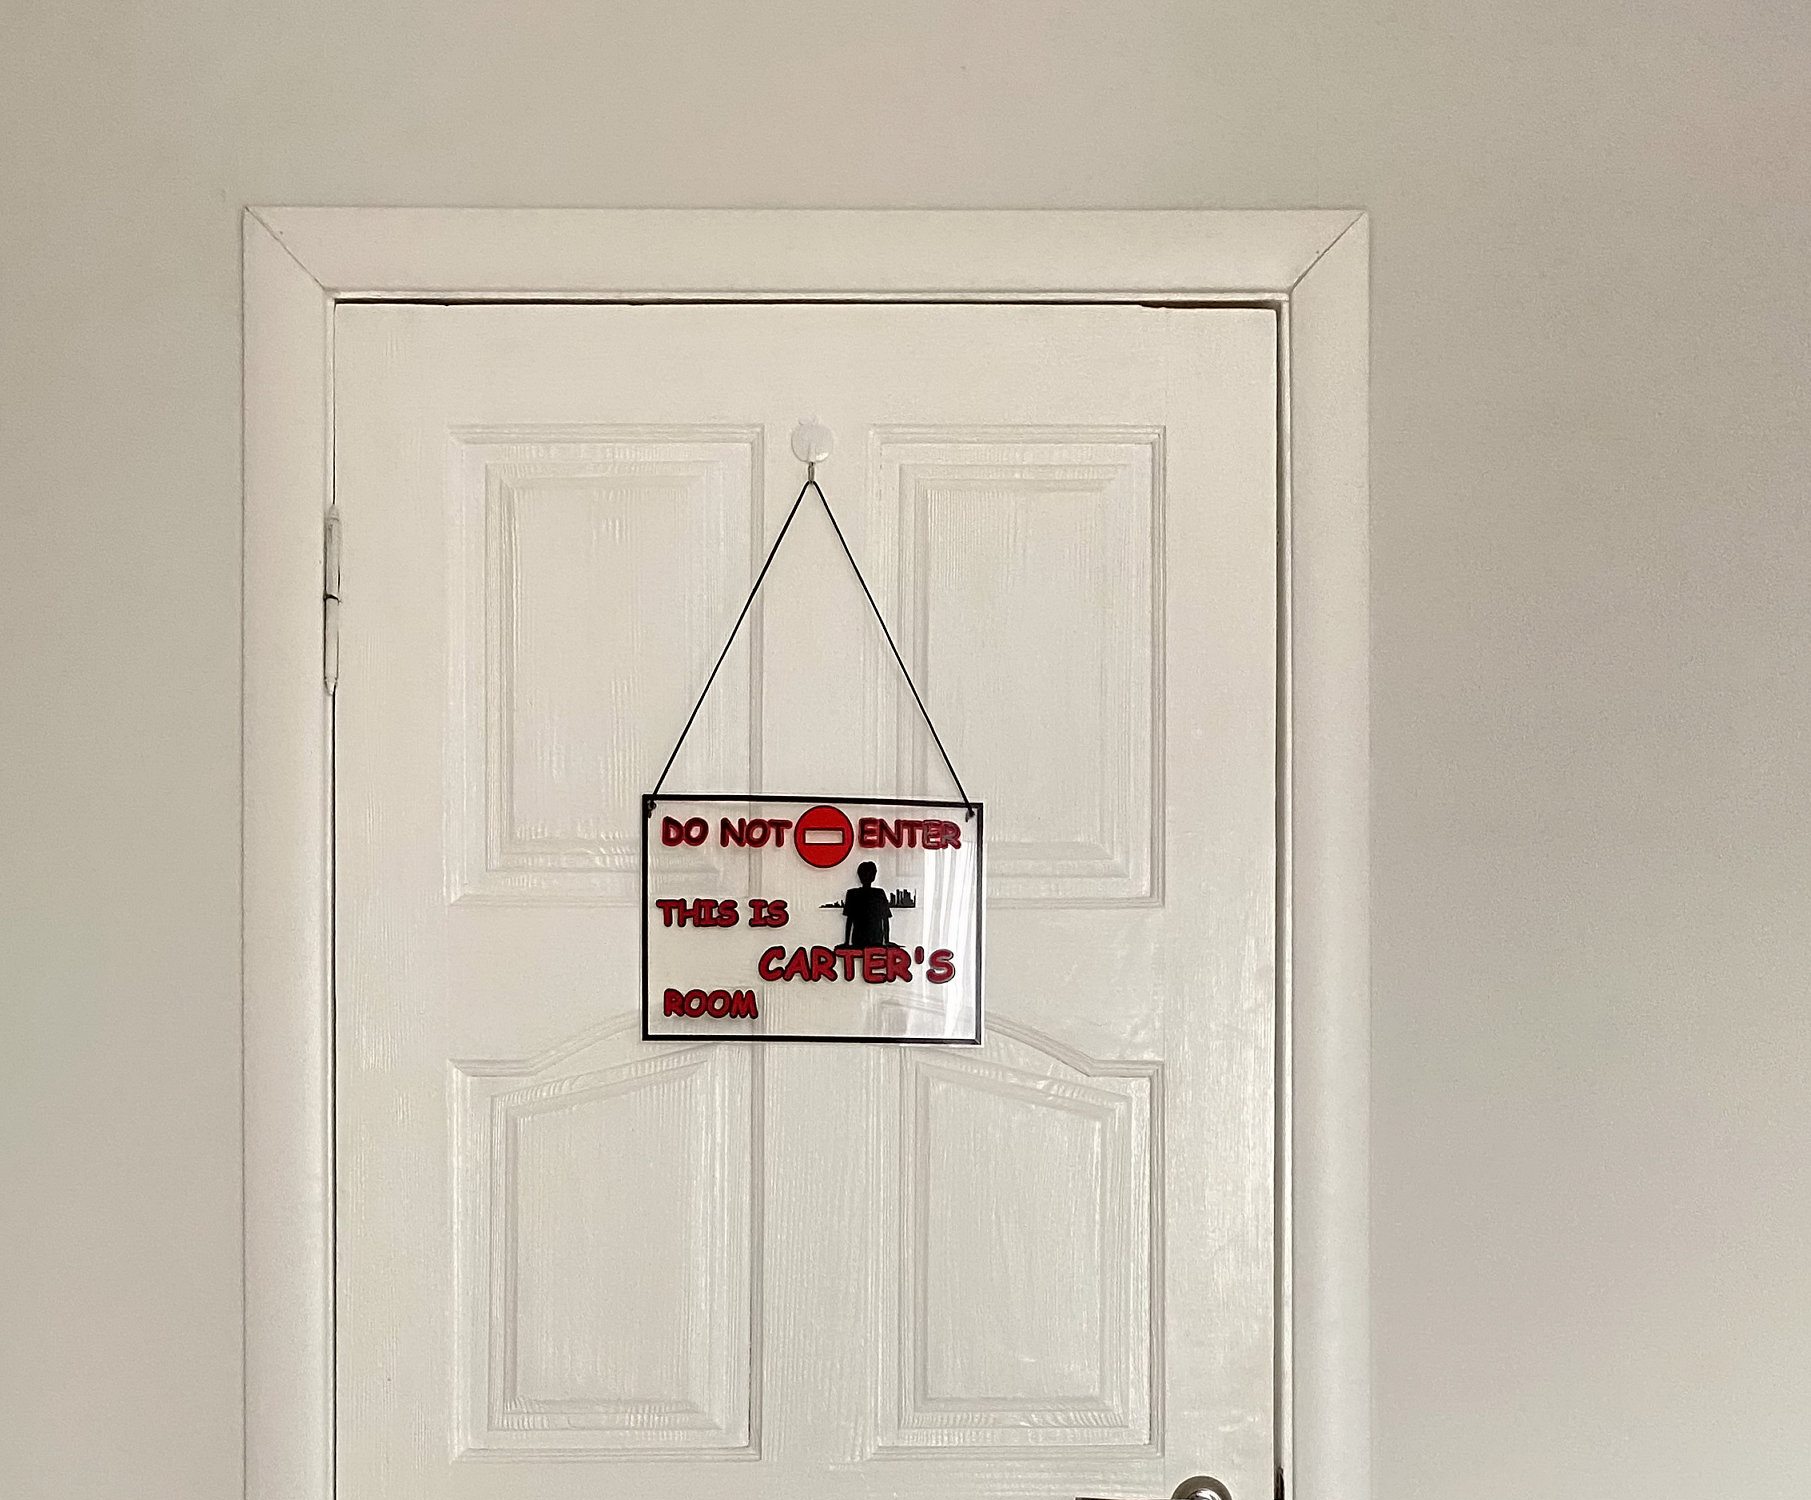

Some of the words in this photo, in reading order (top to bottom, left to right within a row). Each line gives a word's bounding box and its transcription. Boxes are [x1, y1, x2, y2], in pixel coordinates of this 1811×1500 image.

[661, 816, 709, 847] DO
[720, 817, 792, 848] NOT
[858, 817, 962, 850] ENTER
[656, 898, 739, 928] THIS
[748, 898, 789, 927] IS
[758, 945, 956, 984] CARTER'S
[663, 988, 758, 1019] ROOM
